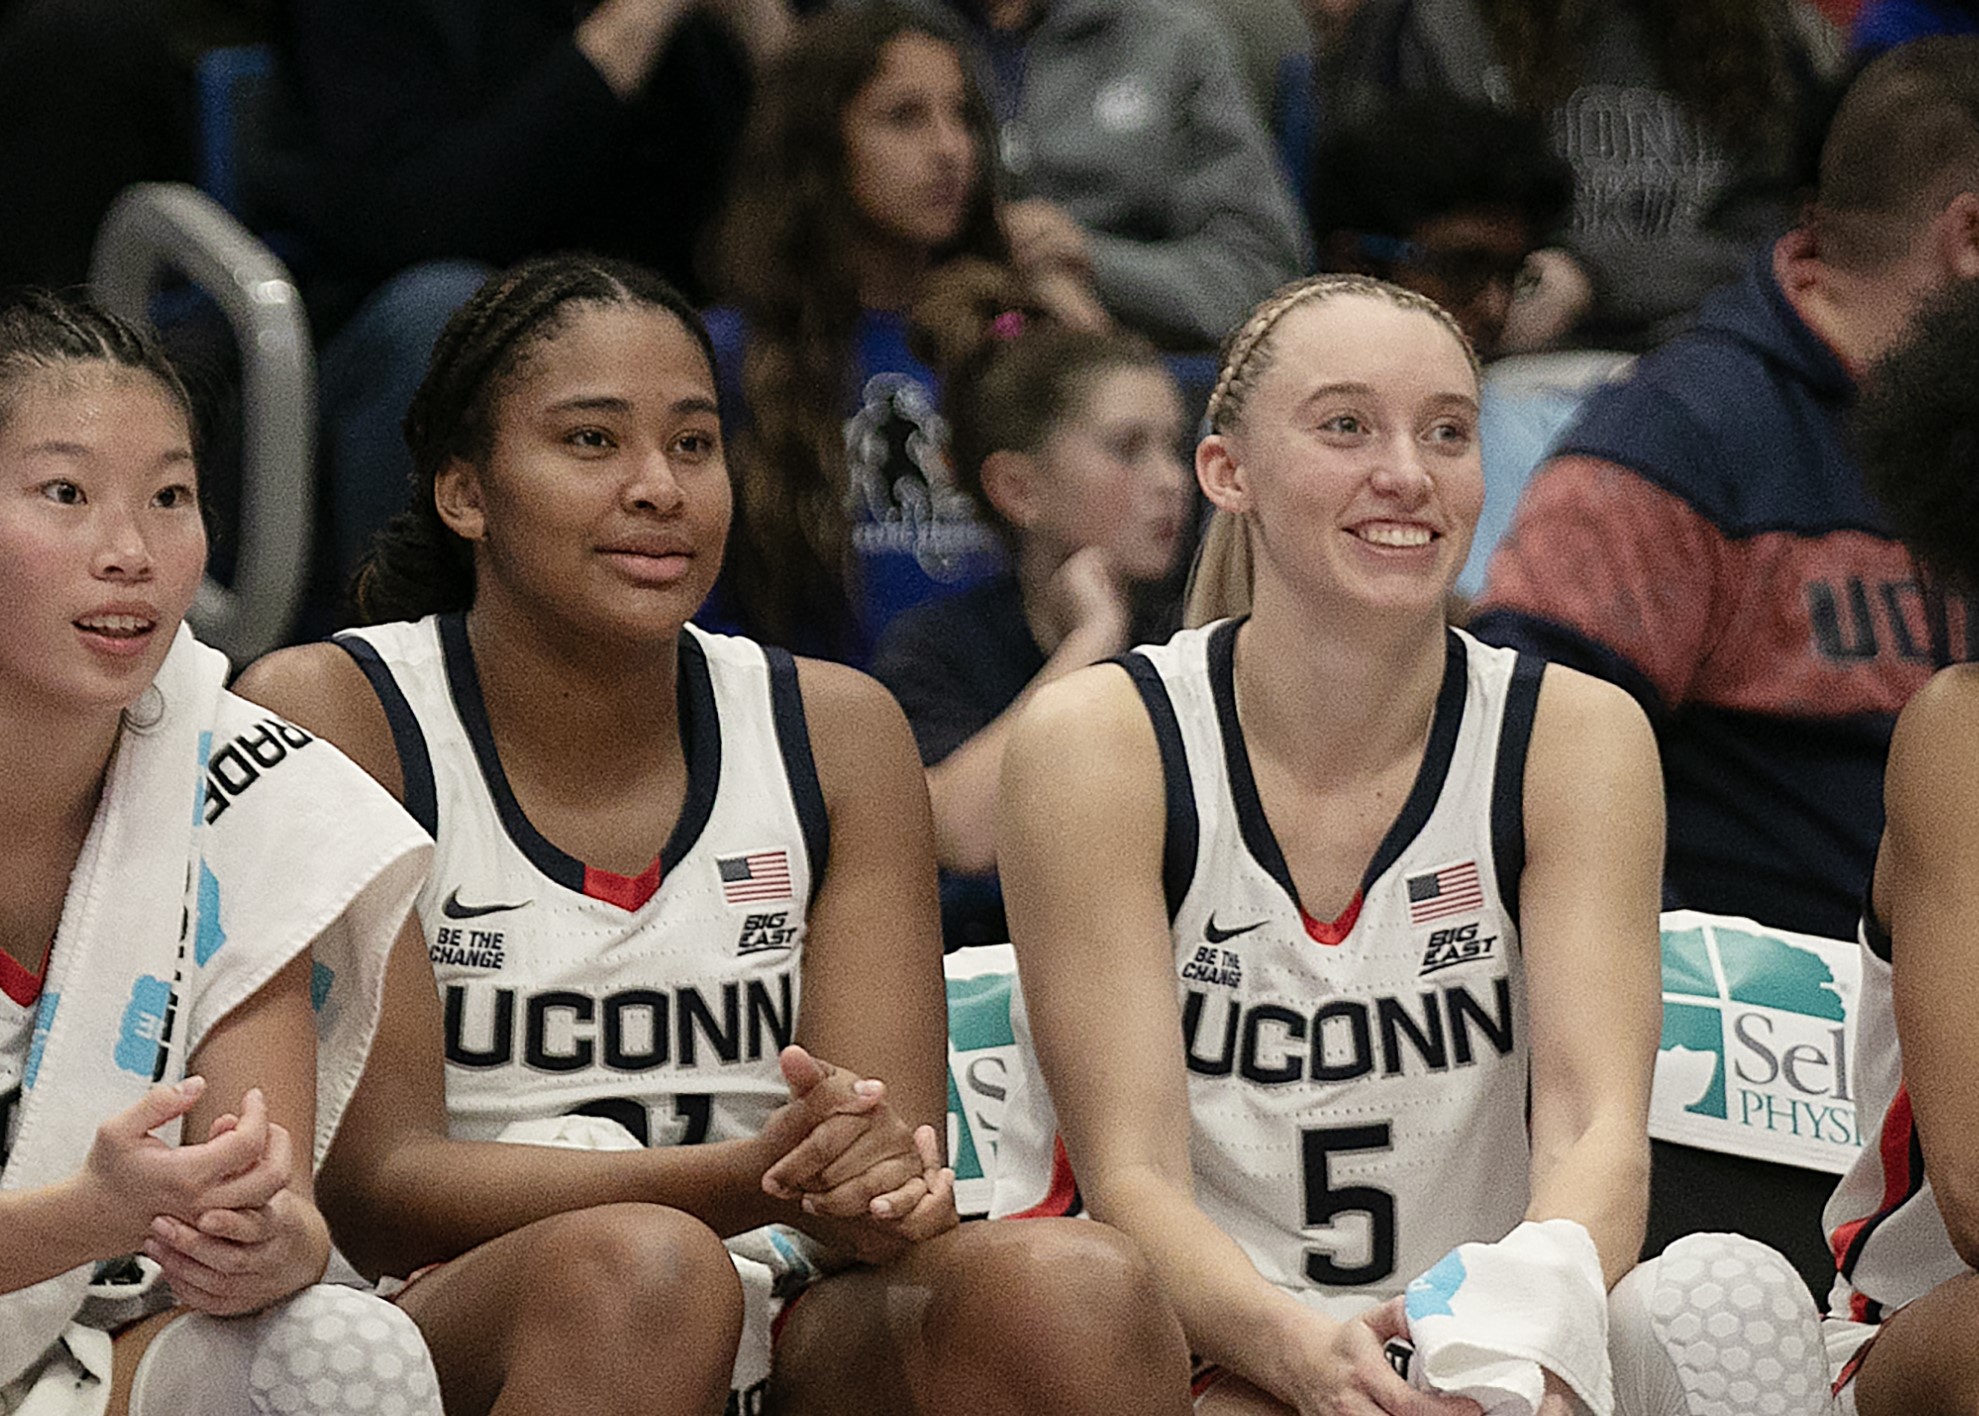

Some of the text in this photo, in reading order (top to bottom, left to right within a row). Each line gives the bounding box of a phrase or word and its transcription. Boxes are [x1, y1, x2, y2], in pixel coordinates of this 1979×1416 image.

[744, 911, 788, 930] BIG
[437, 927, 504, 950] BE THE
[739, 927, 798, 948] EAST
[1428, 922, 1479, 948] BIG
[429, 945, 505, 970] CHANGE
[1195, 946, 1241, 970] BE THE
[1423, 935, 1497, 966] EAST
[1182, 962, 1242, 988] CHANGE
[444, 973, 796, 1073] UCONN
[1181, 978, 1514, 1083] UCONN
[1733, 1012, 1850, 1101] Sel
[1299, 1119, 1397, 1288] 5
